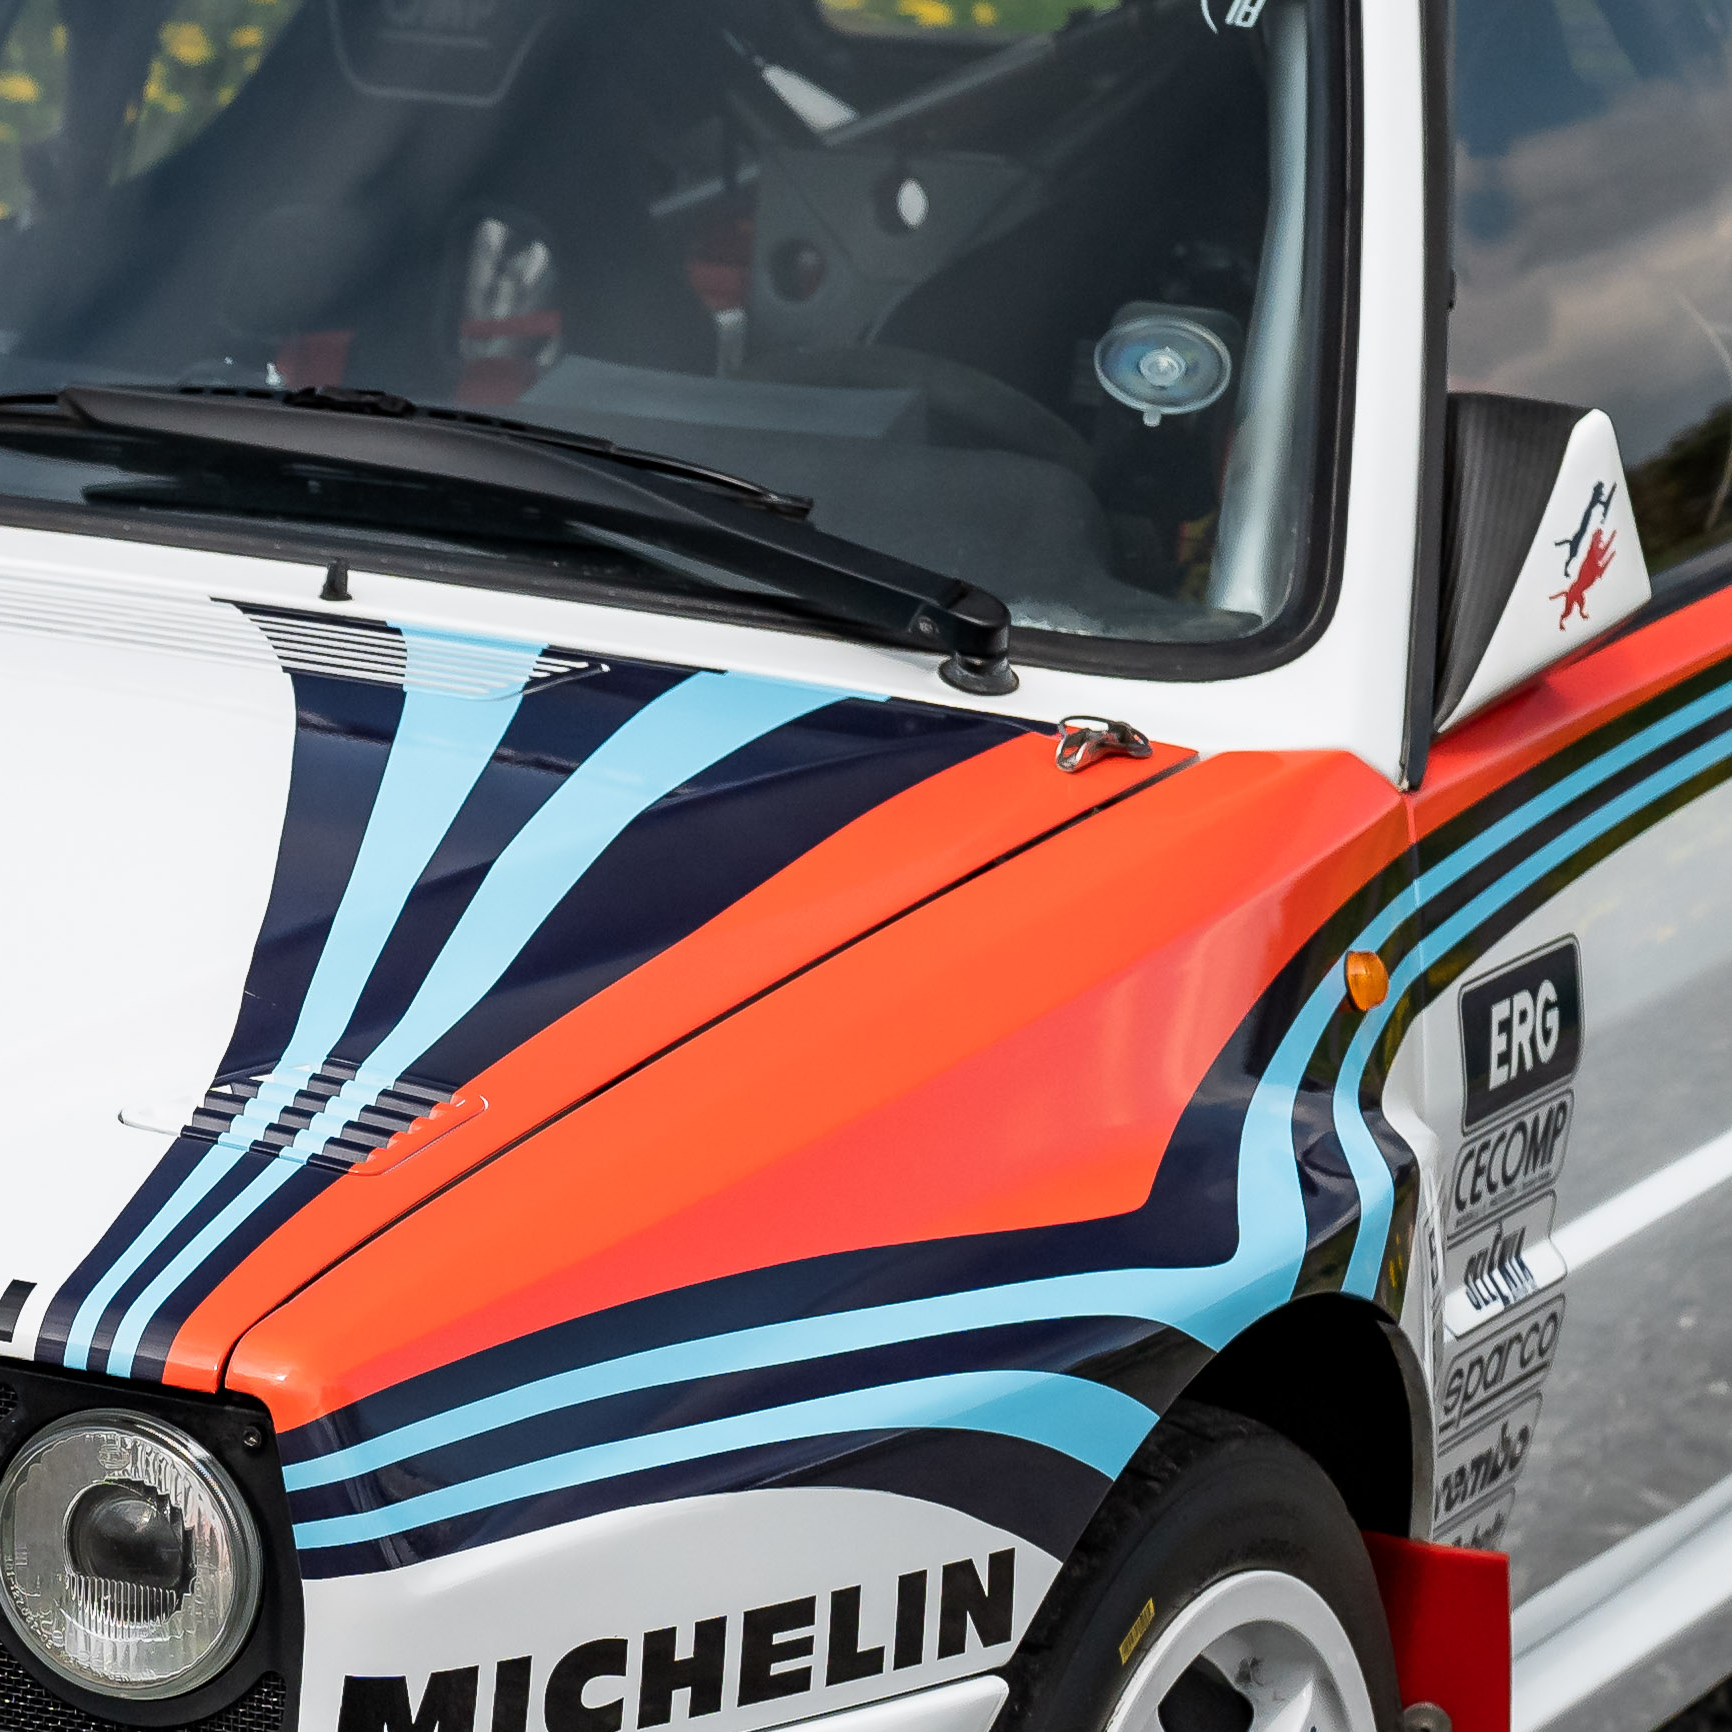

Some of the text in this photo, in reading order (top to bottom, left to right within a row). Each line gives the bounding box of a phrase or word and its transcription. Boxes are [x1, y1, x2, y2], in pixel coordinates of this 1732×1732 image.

[1488, 978, 1561, 1092] ERG
[1454, 1100, 1568, 1212] CECOMP
[1444, 1311, 1559, 1428] sparco
